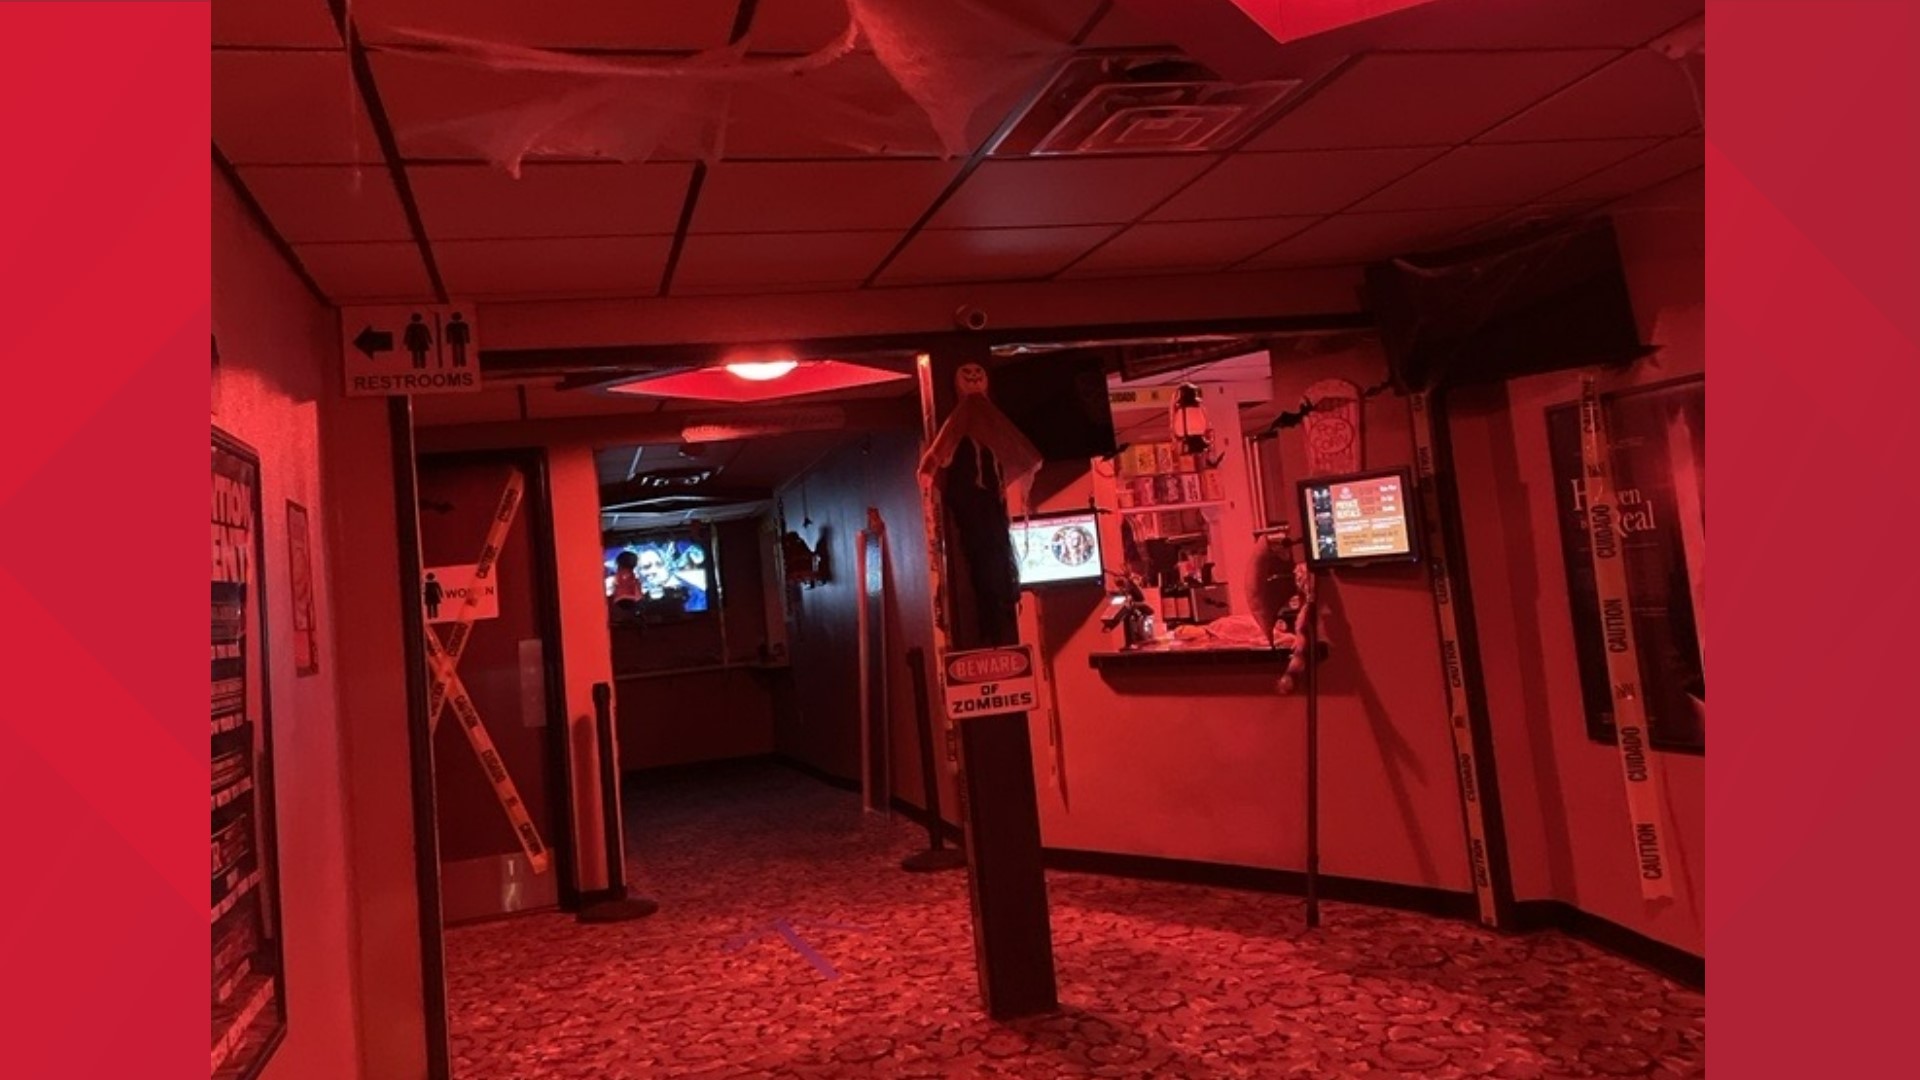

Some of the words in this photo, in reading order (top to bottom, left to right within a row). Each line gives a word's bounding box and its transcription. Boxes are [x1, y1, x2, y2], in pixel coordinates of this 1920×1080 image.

[354, 372, 474, 390] RESTROOMS
[1571, 479, 1641, 511] Hen
[1590, 504, 1616, 559] CUIDADO
[445, 586, 494, 598] WON
[1603, 598, 1628, 653] CAUTION
[956, 655, 1019, 678] BEWARE
[1445, 639, 1461, 687] CAUTION
[952, 692, 1032, 713] ZOMBIES
[981, 683, 999, 696] OF
[1460, 752, 1477, 802] CUIDADO
[1620, 726, 1648, 782] CUIDADO
[1472, 838, 1489, 888] CAUTION
[1636, 822, 1663, 881] CAUTION
